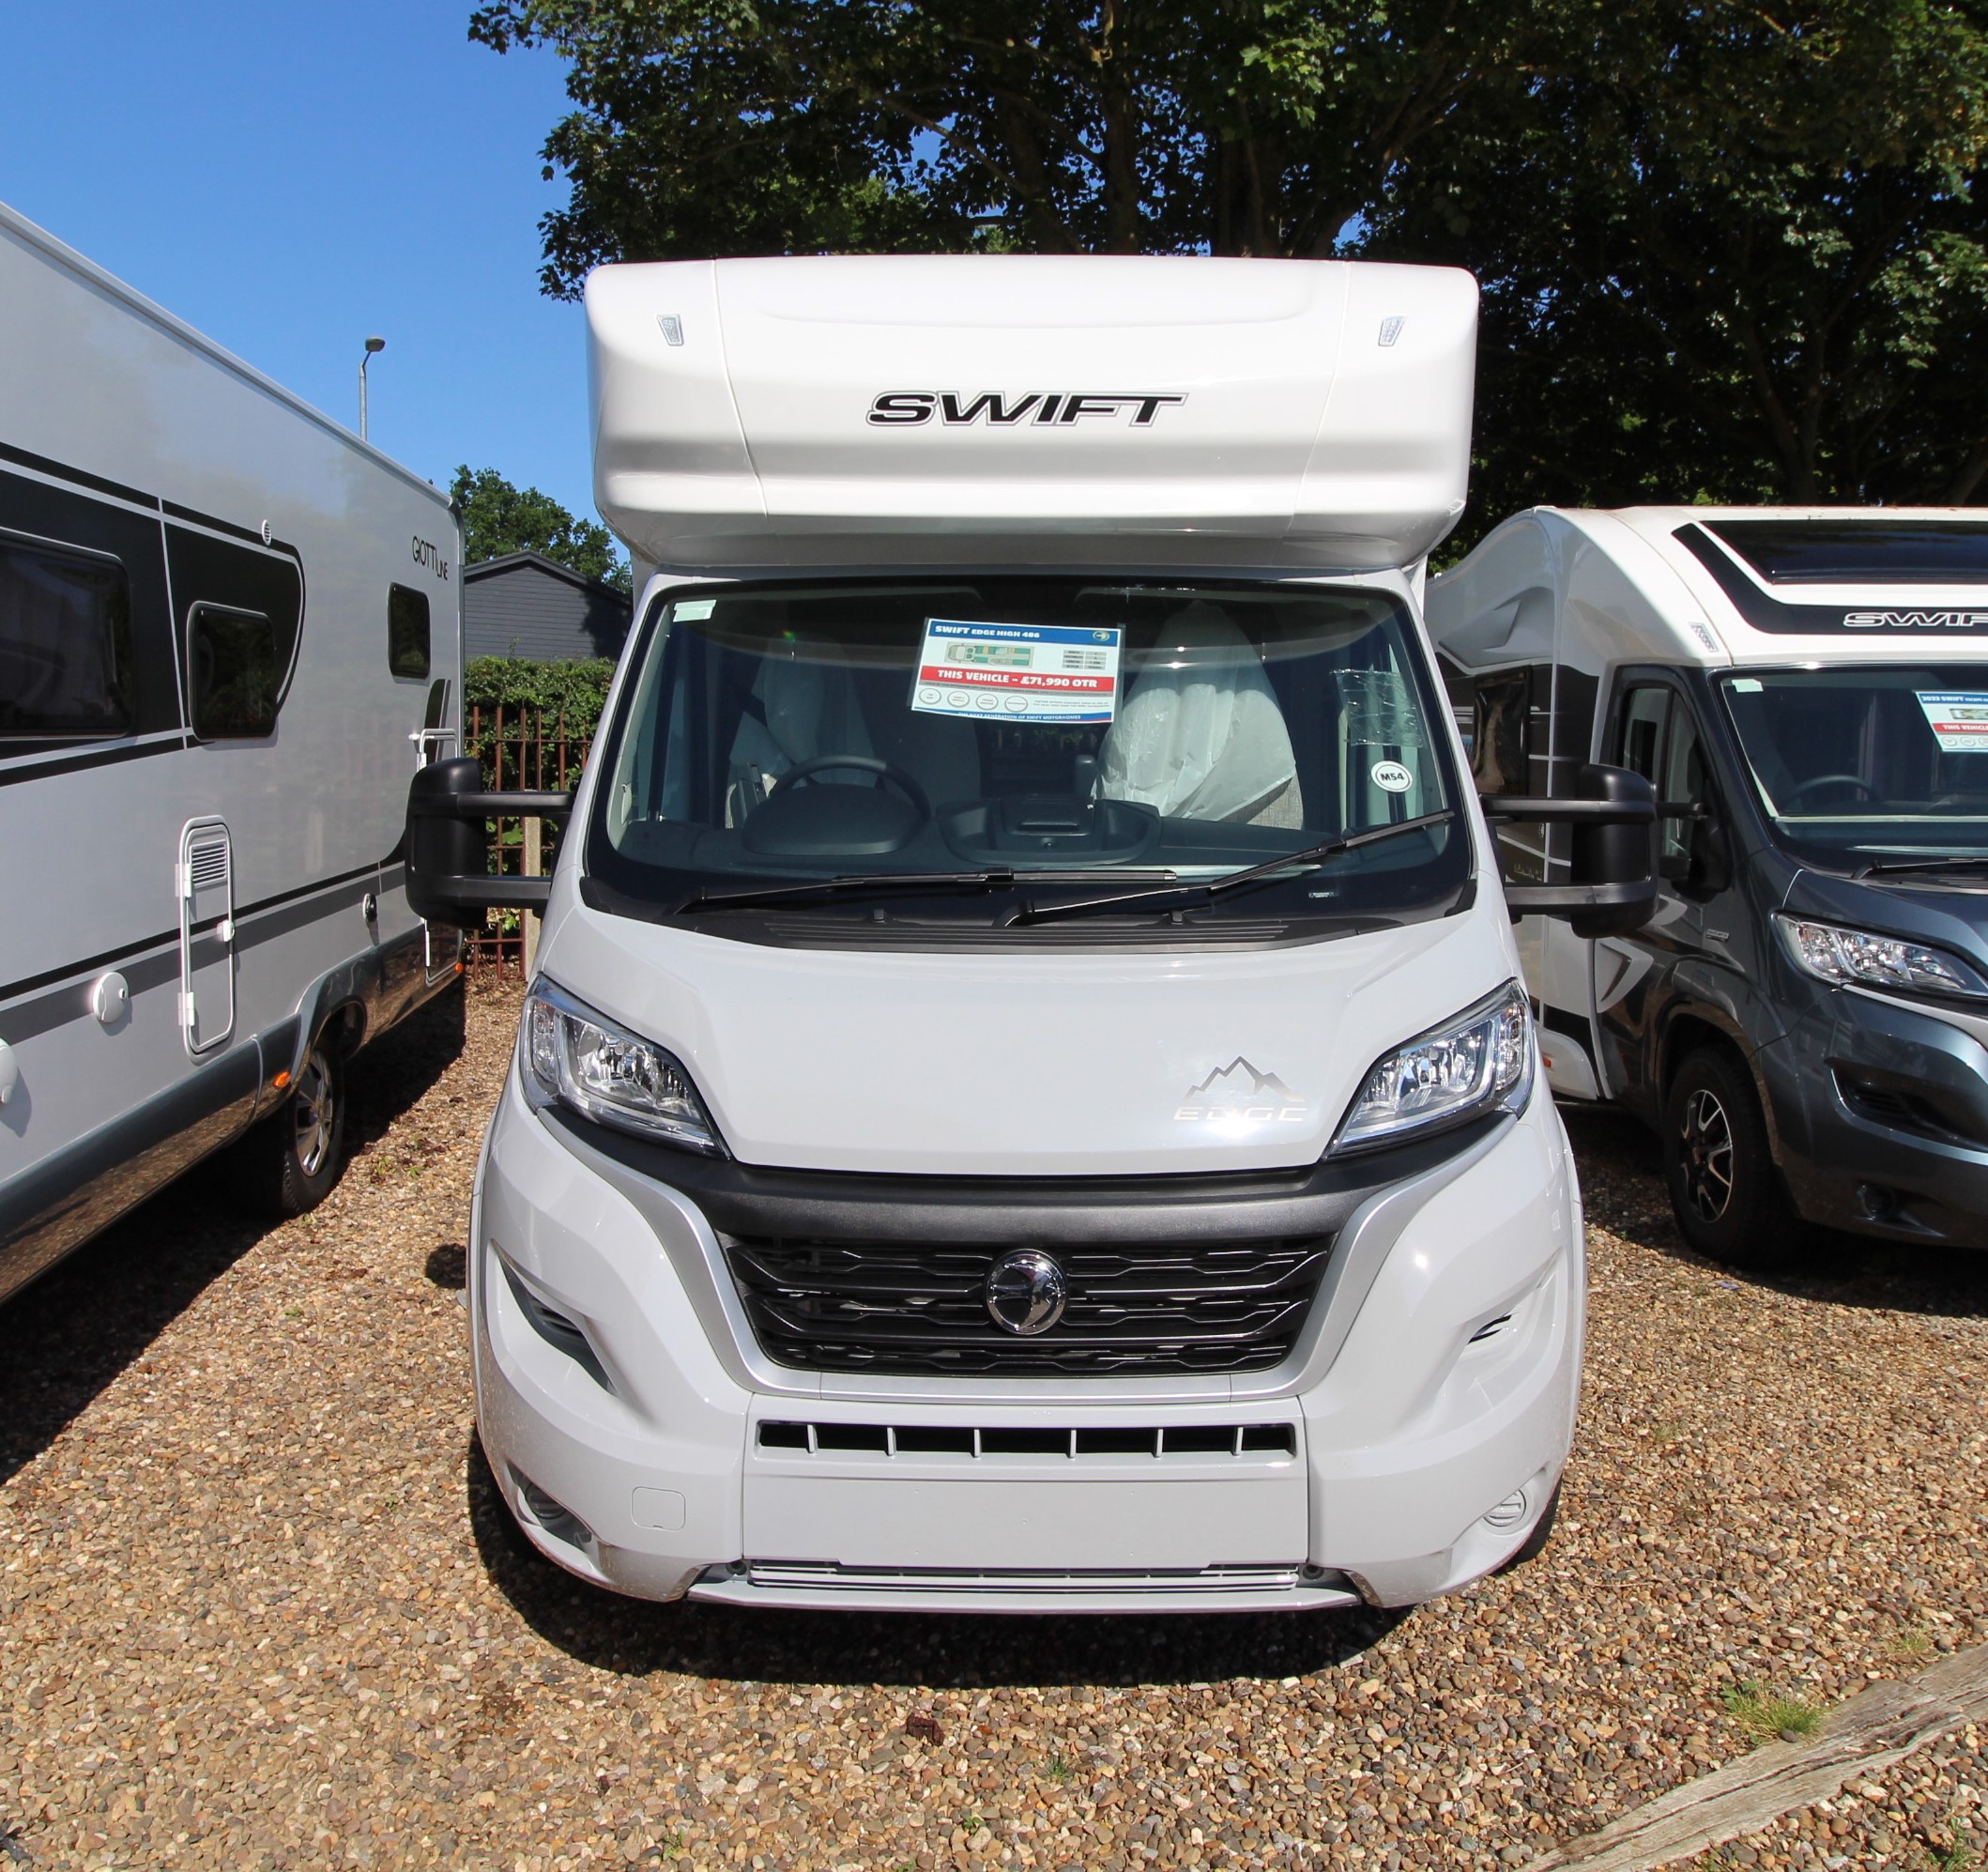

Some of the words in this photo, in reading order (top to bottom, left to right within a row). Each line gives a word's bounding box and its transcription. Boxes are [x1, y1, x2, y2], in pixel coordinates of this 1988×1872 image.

[865, 391, 1189, 427] SWIFT
[935, 625, 971, 635] SWIFT
[938, 669, 963, 680] THIS
[965, 671, 1010, 683] VEHICLE
[1019, 676, 1070, 687] £71,990
[1072, 679, 1098, 688] OTR
[1380, 773, 1405, 781] M54
